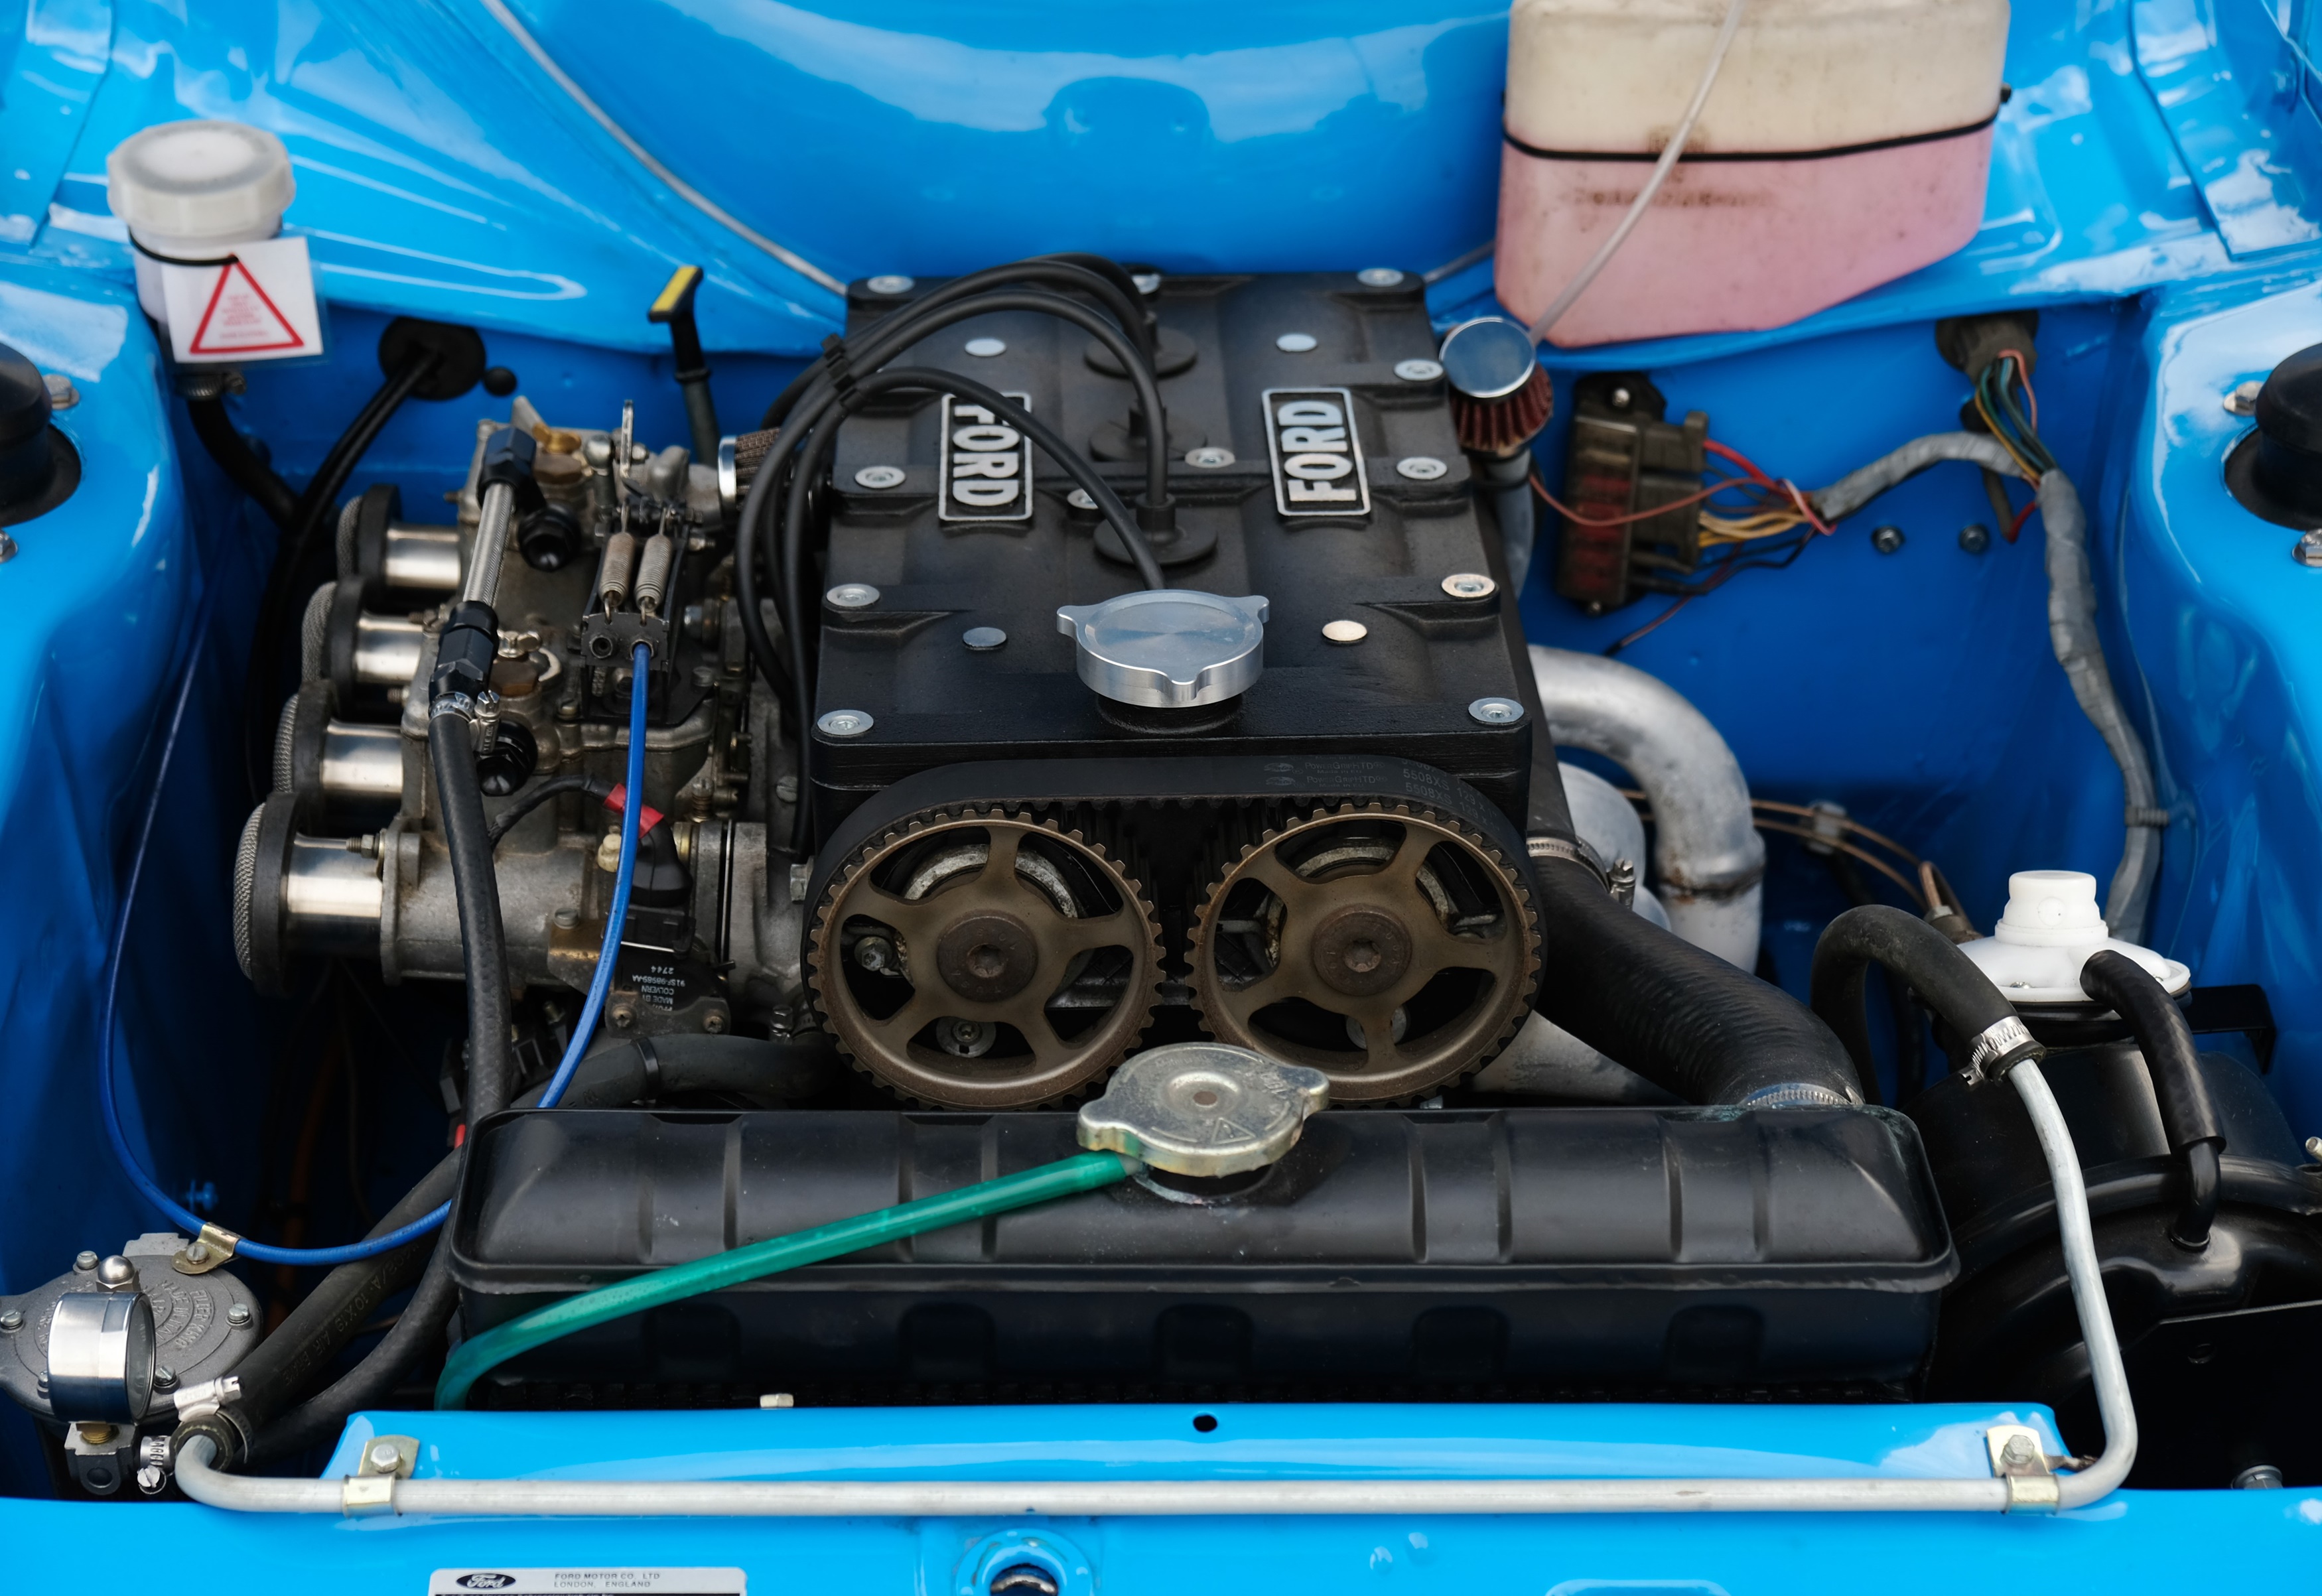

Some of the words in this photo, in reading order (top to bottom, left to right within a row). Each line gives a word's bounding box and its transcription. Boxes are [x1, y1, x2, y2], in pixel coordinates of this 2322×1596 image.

[953, 405, 1020, 507] FORD
[1277, 400, 1357, 502] FORD
[1402, 768, 1450, 791] 5508XS
[1405, 781, 1452, 805] 5508XS
[1457, 787, 1475, 805] 129
[641, 985, 674, 995] COLVERN
[652, 995, 673, 1005] MADE
[312, 1331, 331, 1355] AIR
[467, 1574, 507, 1589] Ford
